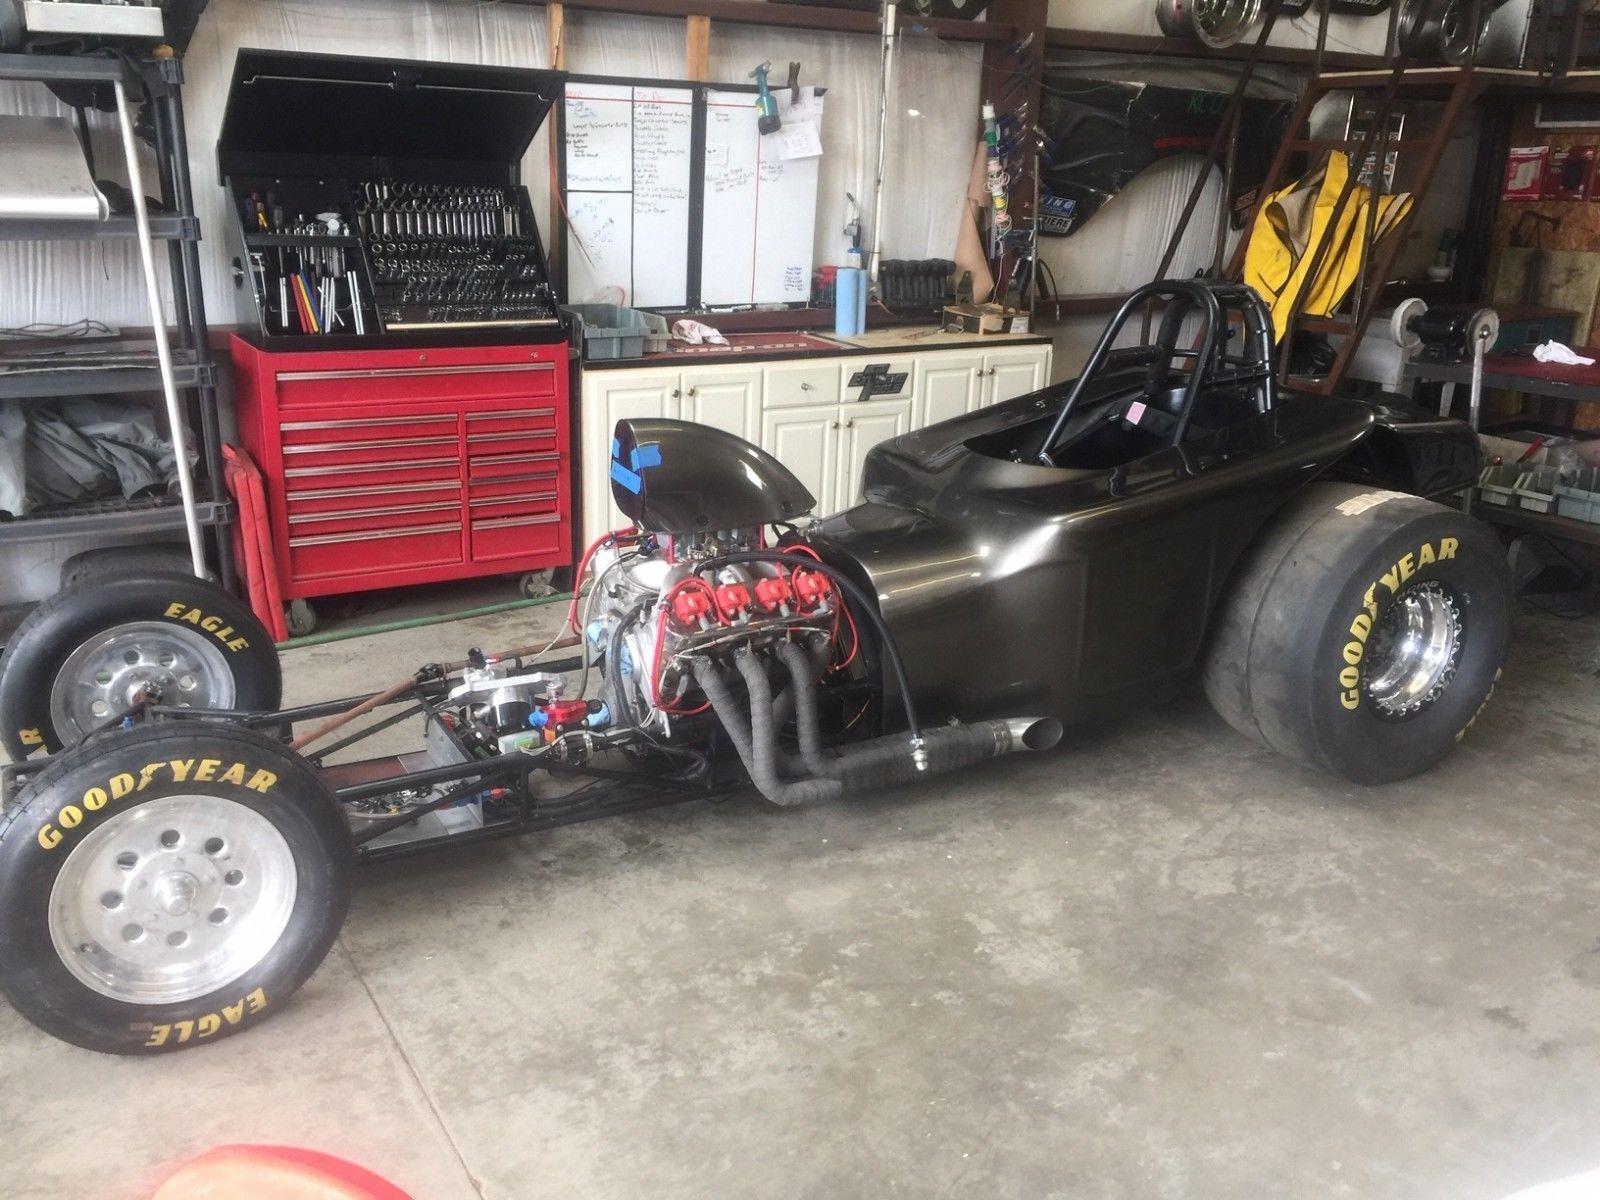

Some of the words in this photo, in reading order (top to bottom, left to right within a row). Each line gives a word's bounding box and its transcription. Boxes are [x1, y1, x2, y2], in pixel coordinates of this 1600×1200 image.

[164, 601, 250, 654] EAGLE
[1339, 537, 1460, 711] GOODYEAR
[38, 759, 279, 850] GOODYEAR
[145, 987, 267, 1046] EAGLE
